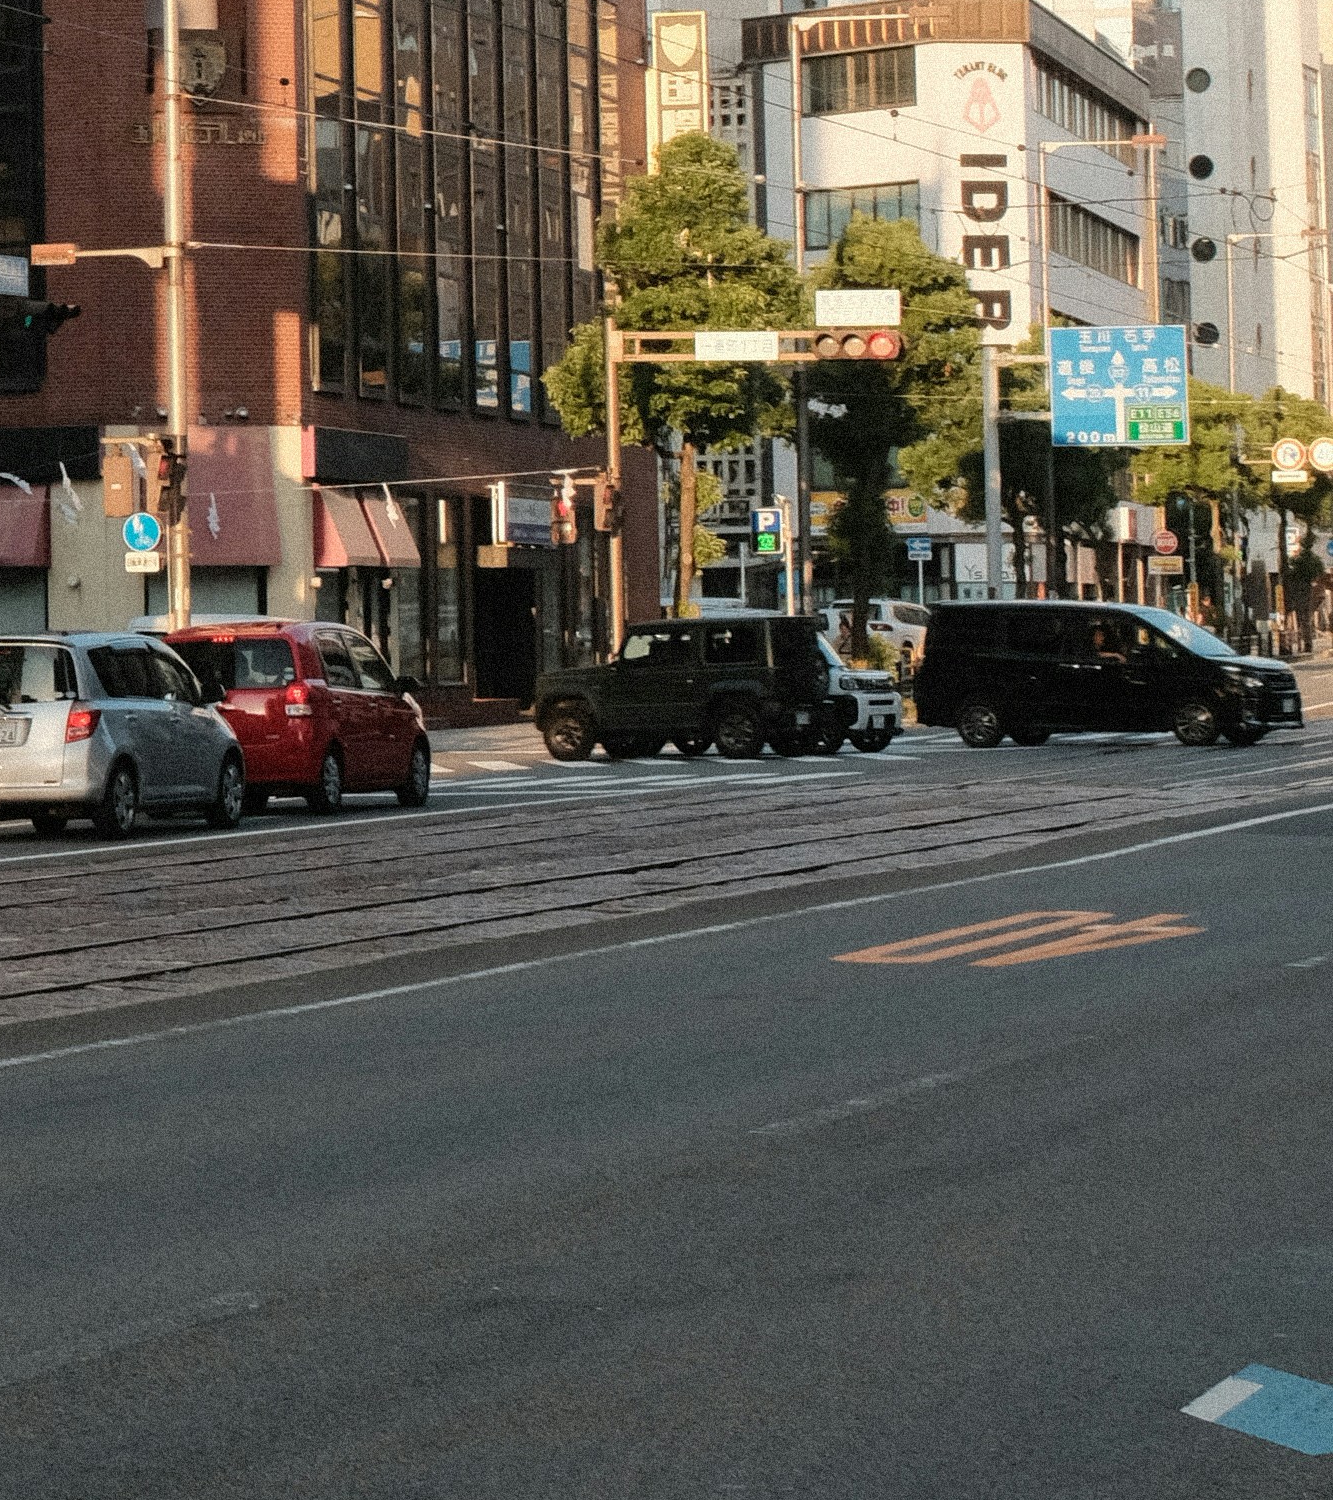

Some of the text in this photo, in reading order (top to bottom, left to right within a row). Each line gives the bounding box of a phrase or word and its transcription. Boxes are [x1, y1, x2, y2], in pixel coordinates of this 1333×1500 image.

[1142, 357, 1181, 373] 高松
[1066, 431, 1116, 443] 200m
[758, 512, 775, 532] P
